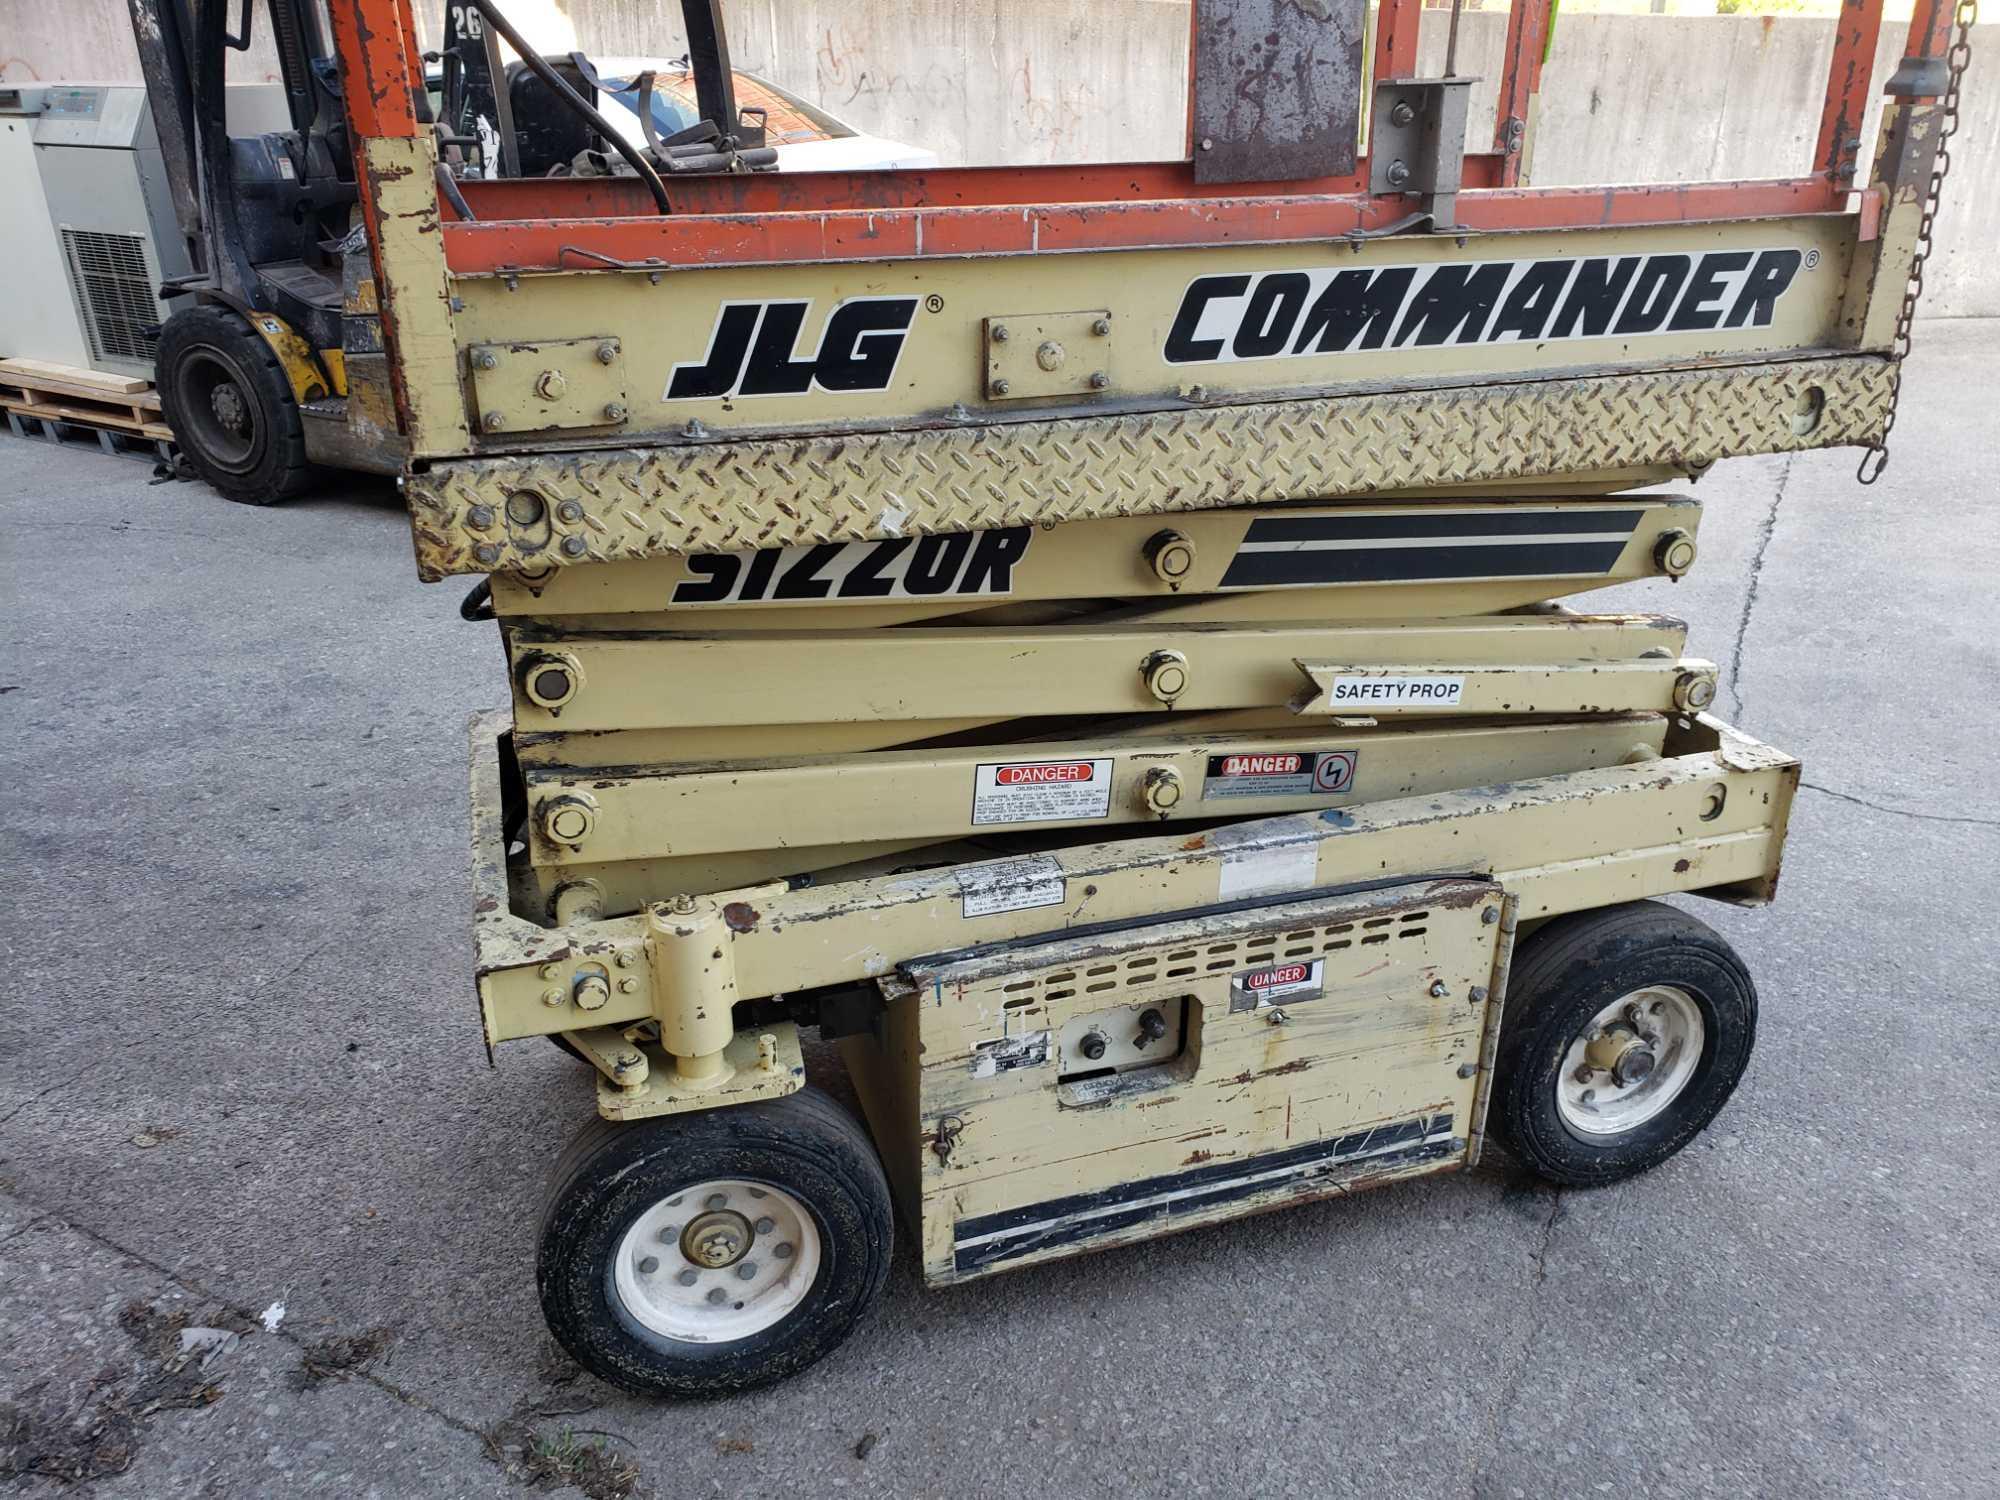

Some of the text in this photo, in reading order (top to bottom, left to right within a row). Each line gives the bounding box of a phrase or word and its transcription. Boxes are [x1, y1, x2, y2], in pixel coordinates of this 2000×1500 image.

[452, 6, 481, 40] 26
[1335, 683, 1460, 699] SAFETY PROP
[1227, 756, 1298, 773] DANGER
[1011, 767, 1079, 782] DANGER
[1254, 967, 1301, 986] DANGER
